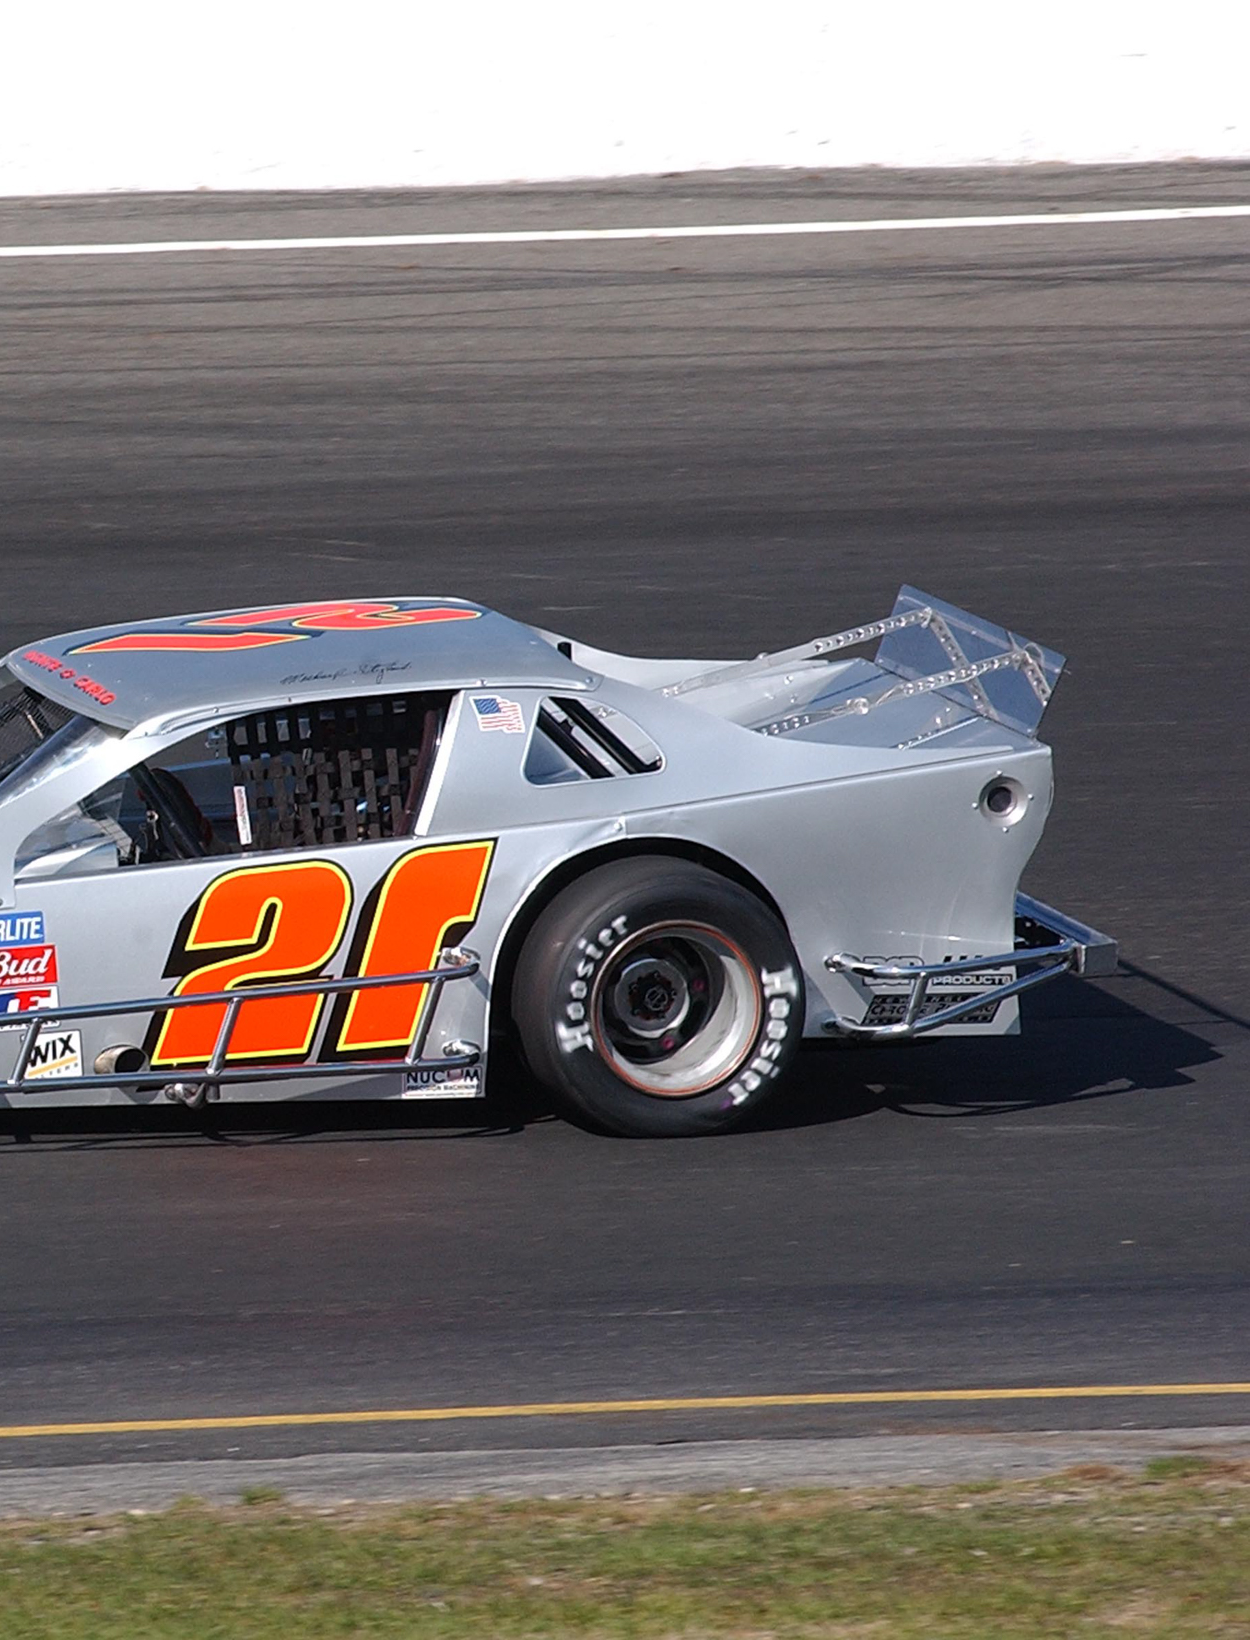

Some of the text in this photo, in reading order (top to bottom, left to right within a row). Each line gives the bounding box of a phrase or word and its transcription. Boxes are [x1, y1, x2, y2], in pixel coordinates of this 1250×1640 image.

[143, 838, 498, 1066] 21
[2, 975, 46, 986] AWARD
[870, 1003, 929, 1016] CHROE
[29, 1033, 77, 1068] WIX
